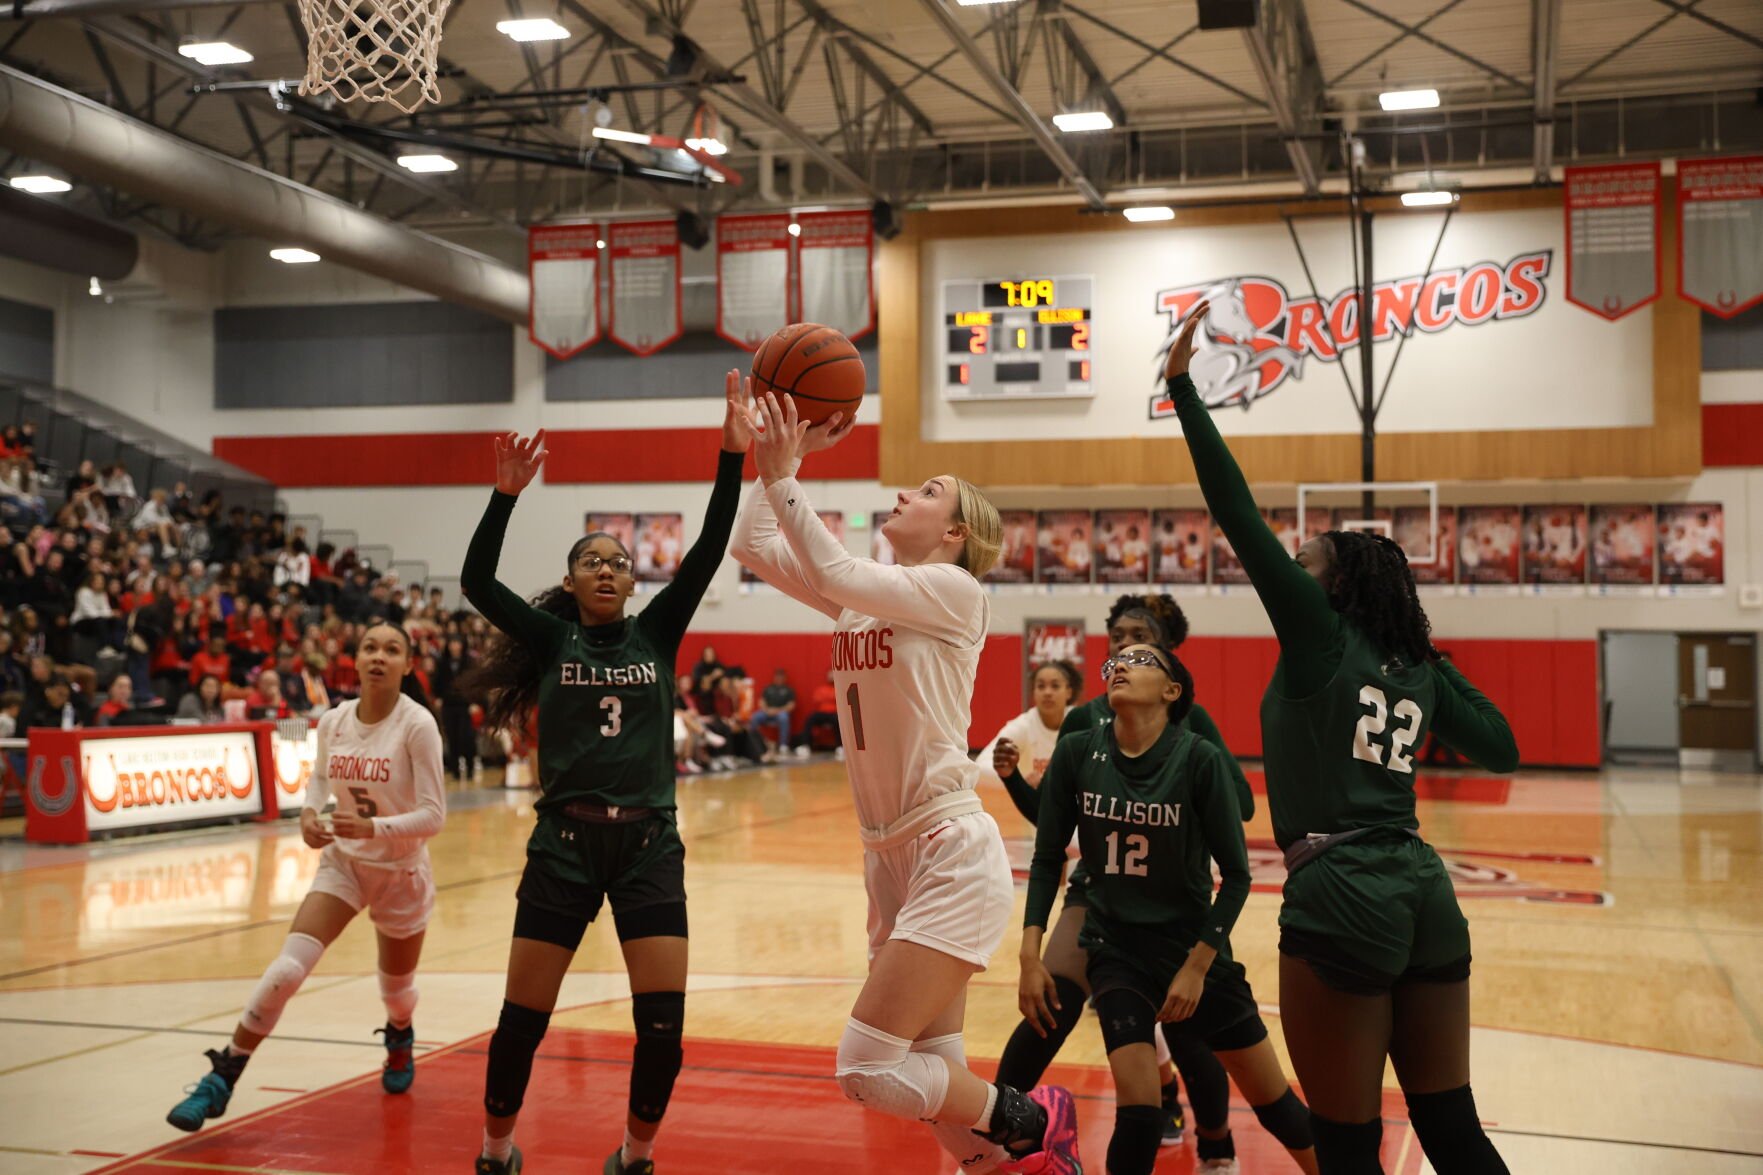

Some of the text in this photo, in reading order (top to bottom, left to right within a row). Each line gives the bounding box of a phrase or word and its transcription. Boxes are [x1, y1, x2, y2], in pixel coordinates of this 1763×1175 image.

[1000, 280, 1054, 307] 7:09
[969, 325, 988, 354] 2
[1017, 328, 1026, 349] 1
[1071, 322, 1089, 350] 2
[1149, 248, 1553, 420] BRONCOS
[959, 363, 970, 385] 1
[1081, 360, 1090, 381] 1
[560, 662, 657, 686] ELLISON
[599, 696, 622, 737] 3
[846, 683, 866, 751] 1
[1353, 684, 1423, 774] 22
[328, 755, 391, 783] BRONCOS
[117, 766, 226, 808] BRONCOS
[347, 786, 378, 819] 5
[1083, 791, 1182, 827] ELLISON
[1104, 831, 1149, 877] 12
